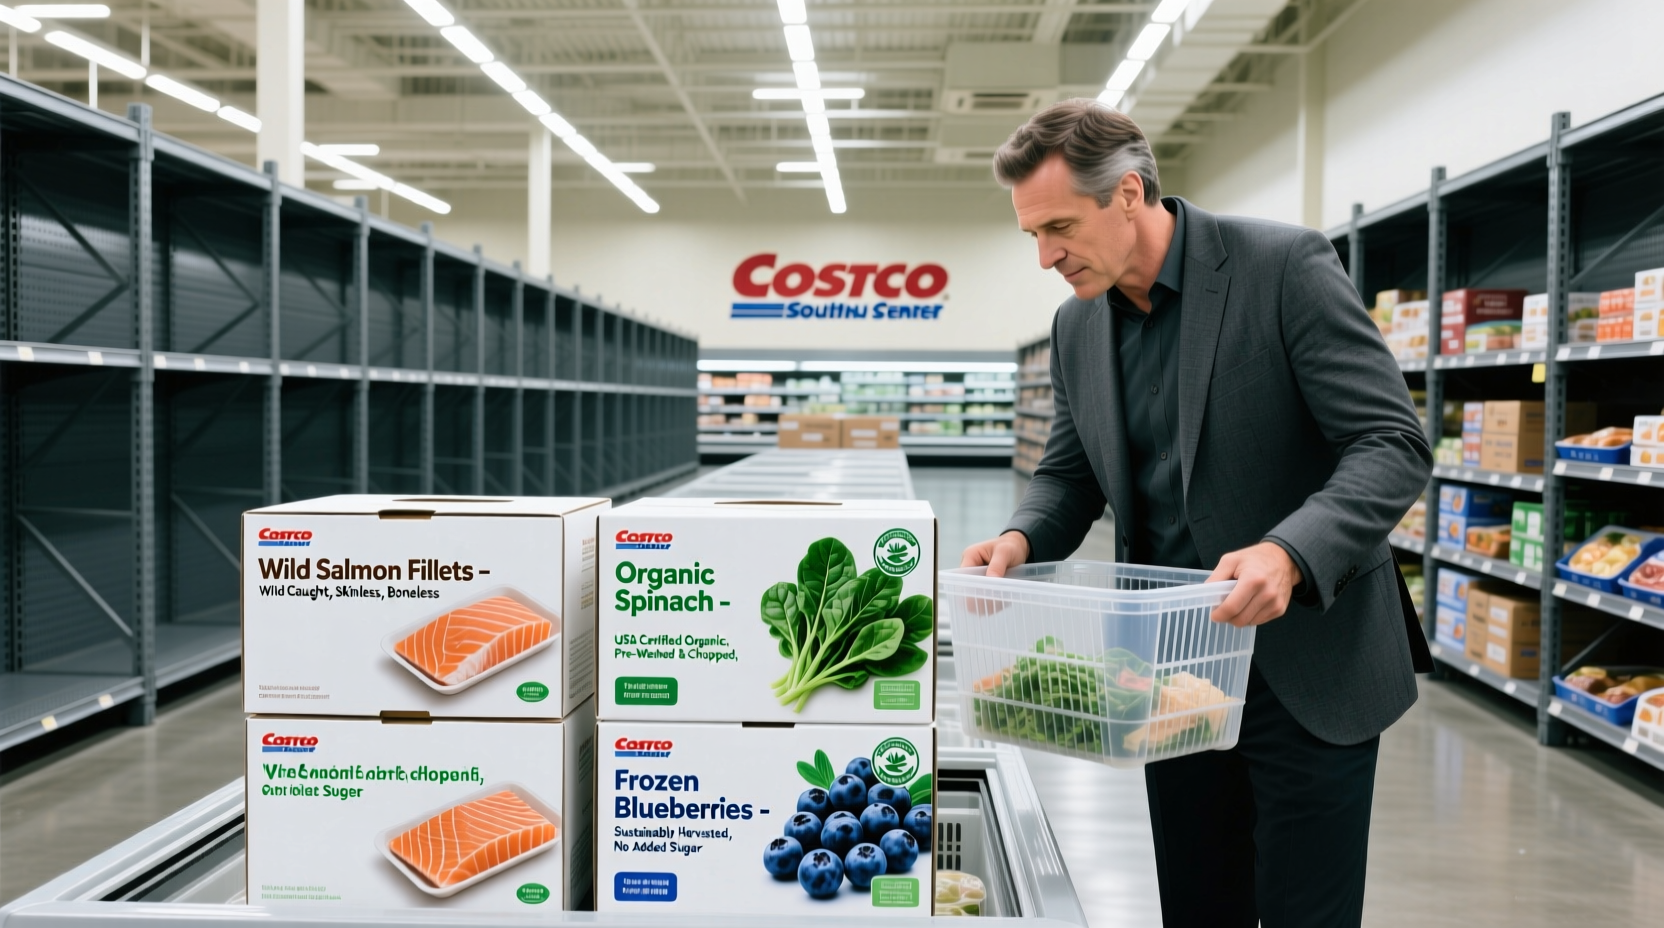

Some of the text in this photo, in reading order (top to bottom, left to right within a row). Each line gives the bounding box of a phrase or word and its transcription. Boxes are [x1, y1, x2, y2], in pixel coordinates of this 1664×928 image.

[733, 253, 948, 298] COSTCO
[258, 558, 310, 579] Wild
[317, 558, 401, 580] Salmon
[409, 559, 473, 581] Fillets
[616, 561, 715, 591] Organic
[388, 585, 439, 598] Boneless
[615, 588, 713, 617] Spinach
[616, 769, 698, 791] Frozen
[615, 796, 753, 820] Blueberries
[614, 841, 703, 856] No Added Sugar
